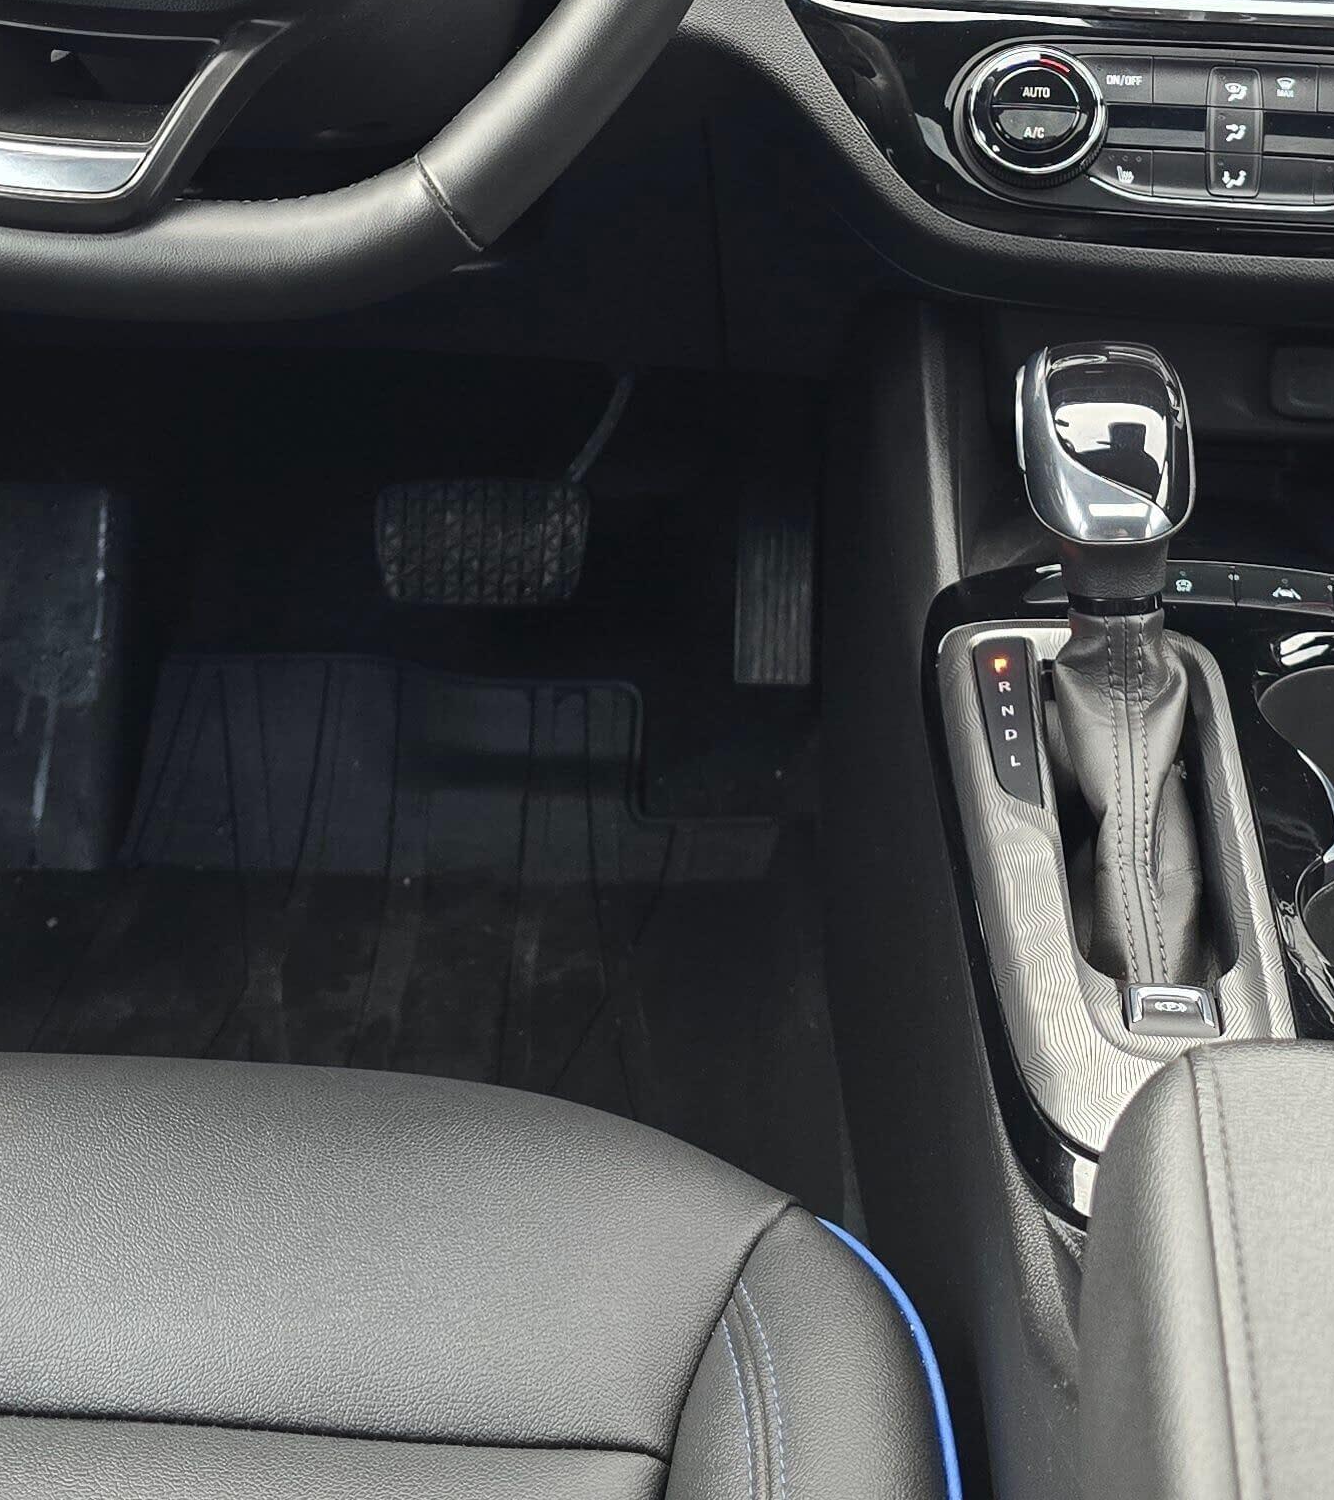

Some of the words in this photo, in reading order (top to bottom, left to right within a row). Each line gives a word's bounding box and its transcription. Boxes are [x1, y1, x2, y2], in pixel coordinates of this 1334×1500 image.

[1105, 74, 1143, 86] ON/OFF
[1021, 86, 1051, 98] AUTO
[1023, 126, 1045, 139] A/C
[993, 658, 1008, 674] P
[998, 681, 1012, 693] R
[1001, 704, 1015, 717] N
[1004, 728, 1018, 741] D
[1010, 754, 1021, 768] L
